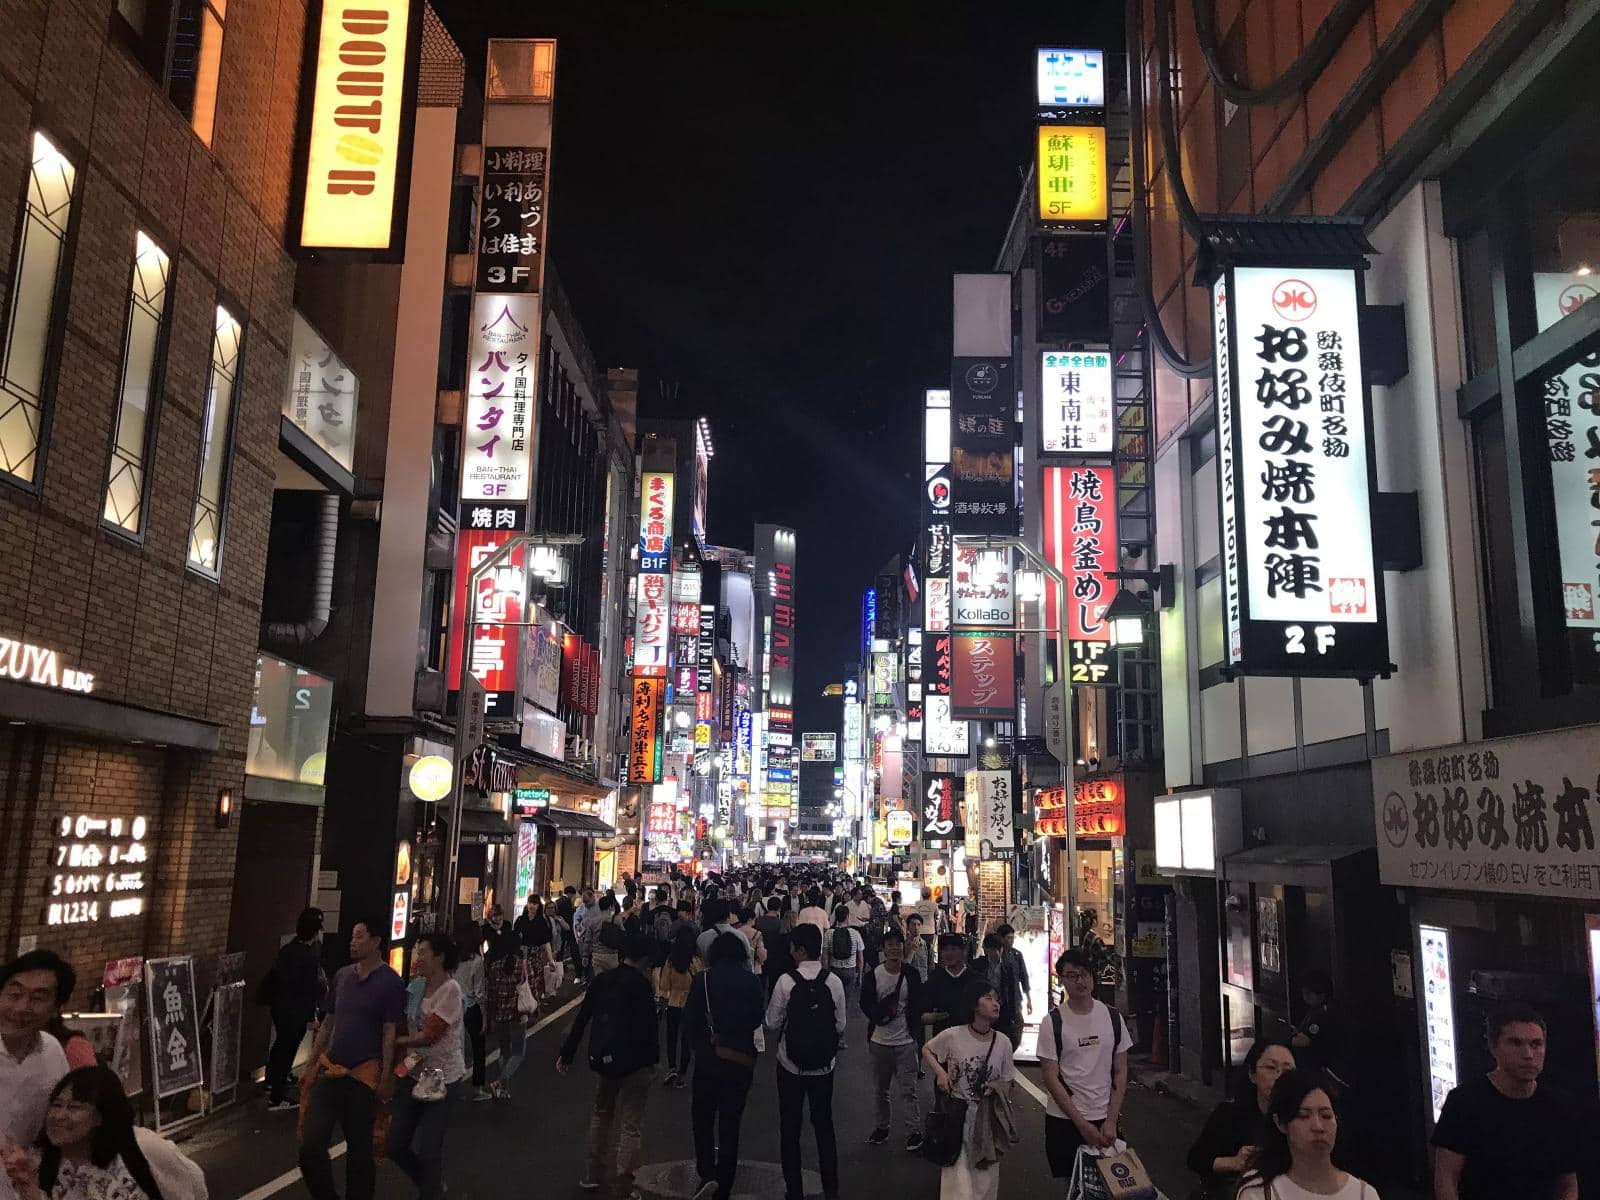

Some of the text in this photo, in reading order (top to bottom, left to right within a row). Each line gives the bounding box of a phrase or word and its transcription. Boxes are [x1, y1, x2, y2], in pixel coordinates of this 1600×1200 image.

[327, 9, 389, 196] DOUTOR
[487, 150, 545, 172] 小料理
[481, 184, 502, 254] いろは
[519, 183, 543, 255] あづま
[1048, 201, 1073, 215] 5F
[487, 266, 531, 284] 3F
[476, 351, 510, 458] バンタイ
[511, 352, 529, 452] タイ国料理専門店
[1060, 371, 1083, 449] 東南荘
[471, 507, 516, 528] 焼肉
[482, 484, 508, 496] 3F
[641, 557, 668, 569] B1F
[1069, 469, 1103, 635] 焼鳥釜めし
[957, 608, 1010, 621] KollaBo
[1284, 625, 1337, 655] 2F
[1072, 663, 1109, 683] 2F
[990, 776, 1011, 840] お好み焼き
[1413, 776, 1600, 853] お好み焼本
[162, 980, 188, 1071] 魚金
